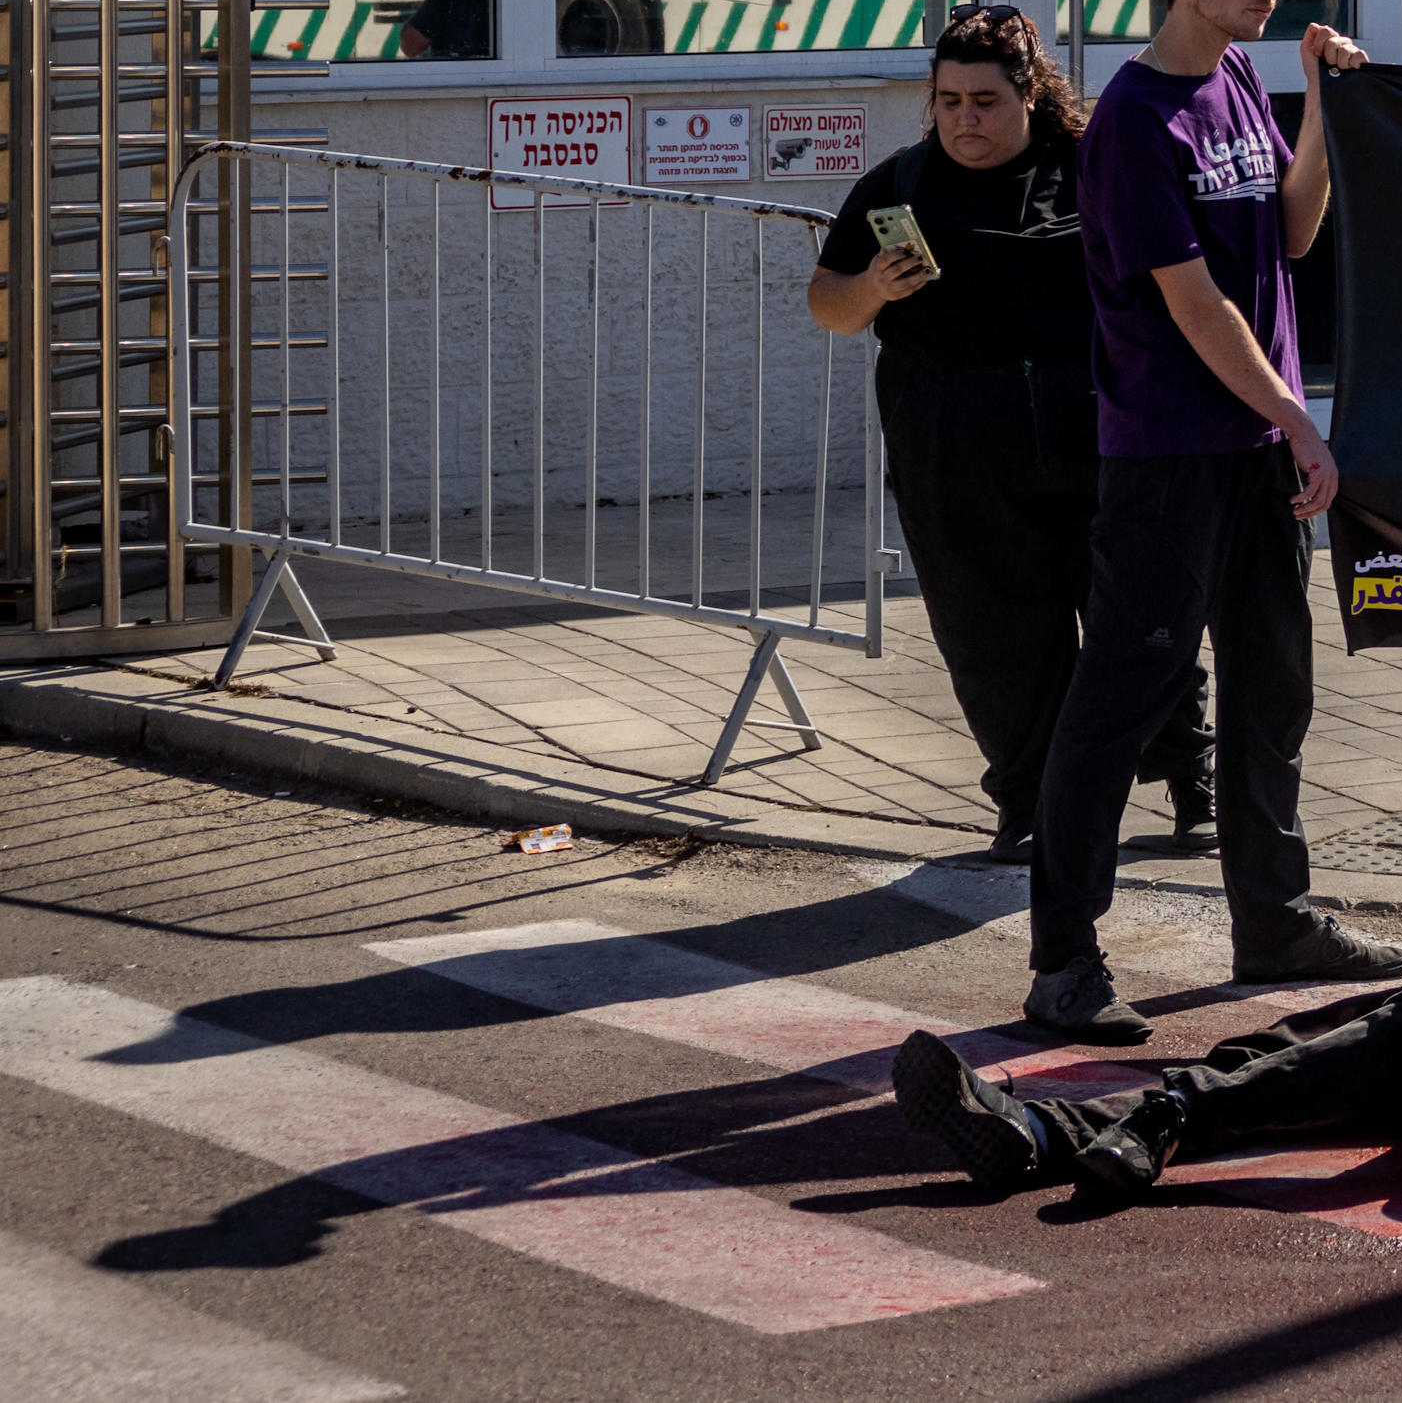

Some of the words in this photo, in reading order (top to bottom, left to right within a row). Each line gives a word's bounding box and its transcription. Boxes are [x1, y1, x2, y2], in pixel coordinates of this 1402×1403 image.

[499, 113, 536, 142] דרך
[547, 110, 622, 135] הכניסה
[770, 112, 812, 131] מצולם
[818, 115, 861, 134] המקום
[710, 143, 739, 151] הכניסה
[814, 139, 840, 150] שעות
[844, 134, 860, 148] 24
[523, 142, 598, 167] סבסבת
[816, 156, 859, 170] ביממה
